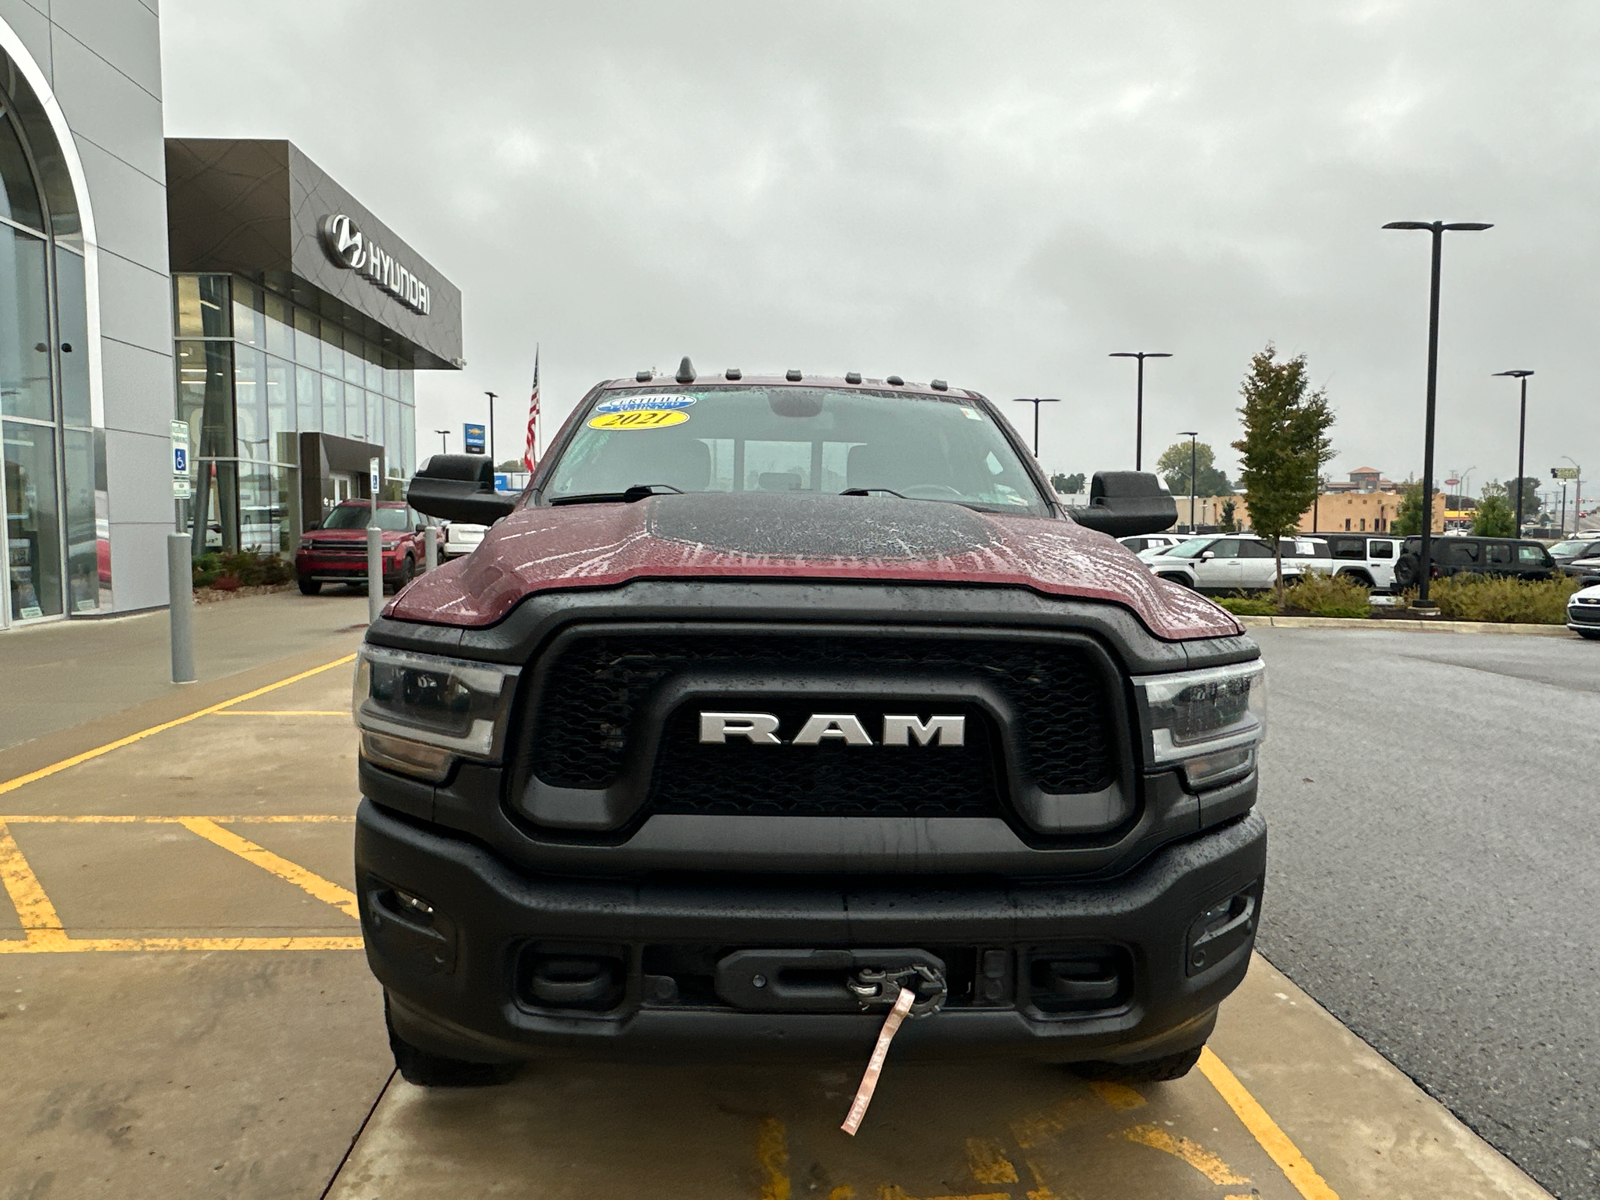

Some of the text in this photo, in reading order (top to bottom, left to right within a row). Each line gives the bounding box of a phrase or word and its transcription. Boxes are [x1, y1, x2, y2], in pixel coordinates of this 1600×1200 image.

[369, 241, 431, 315] HYUNDAI
[609, 395, 686, 406] CERTIFIED
[602, 413, 673, 427] 2021
[699, 711, 966, 747] RAM
